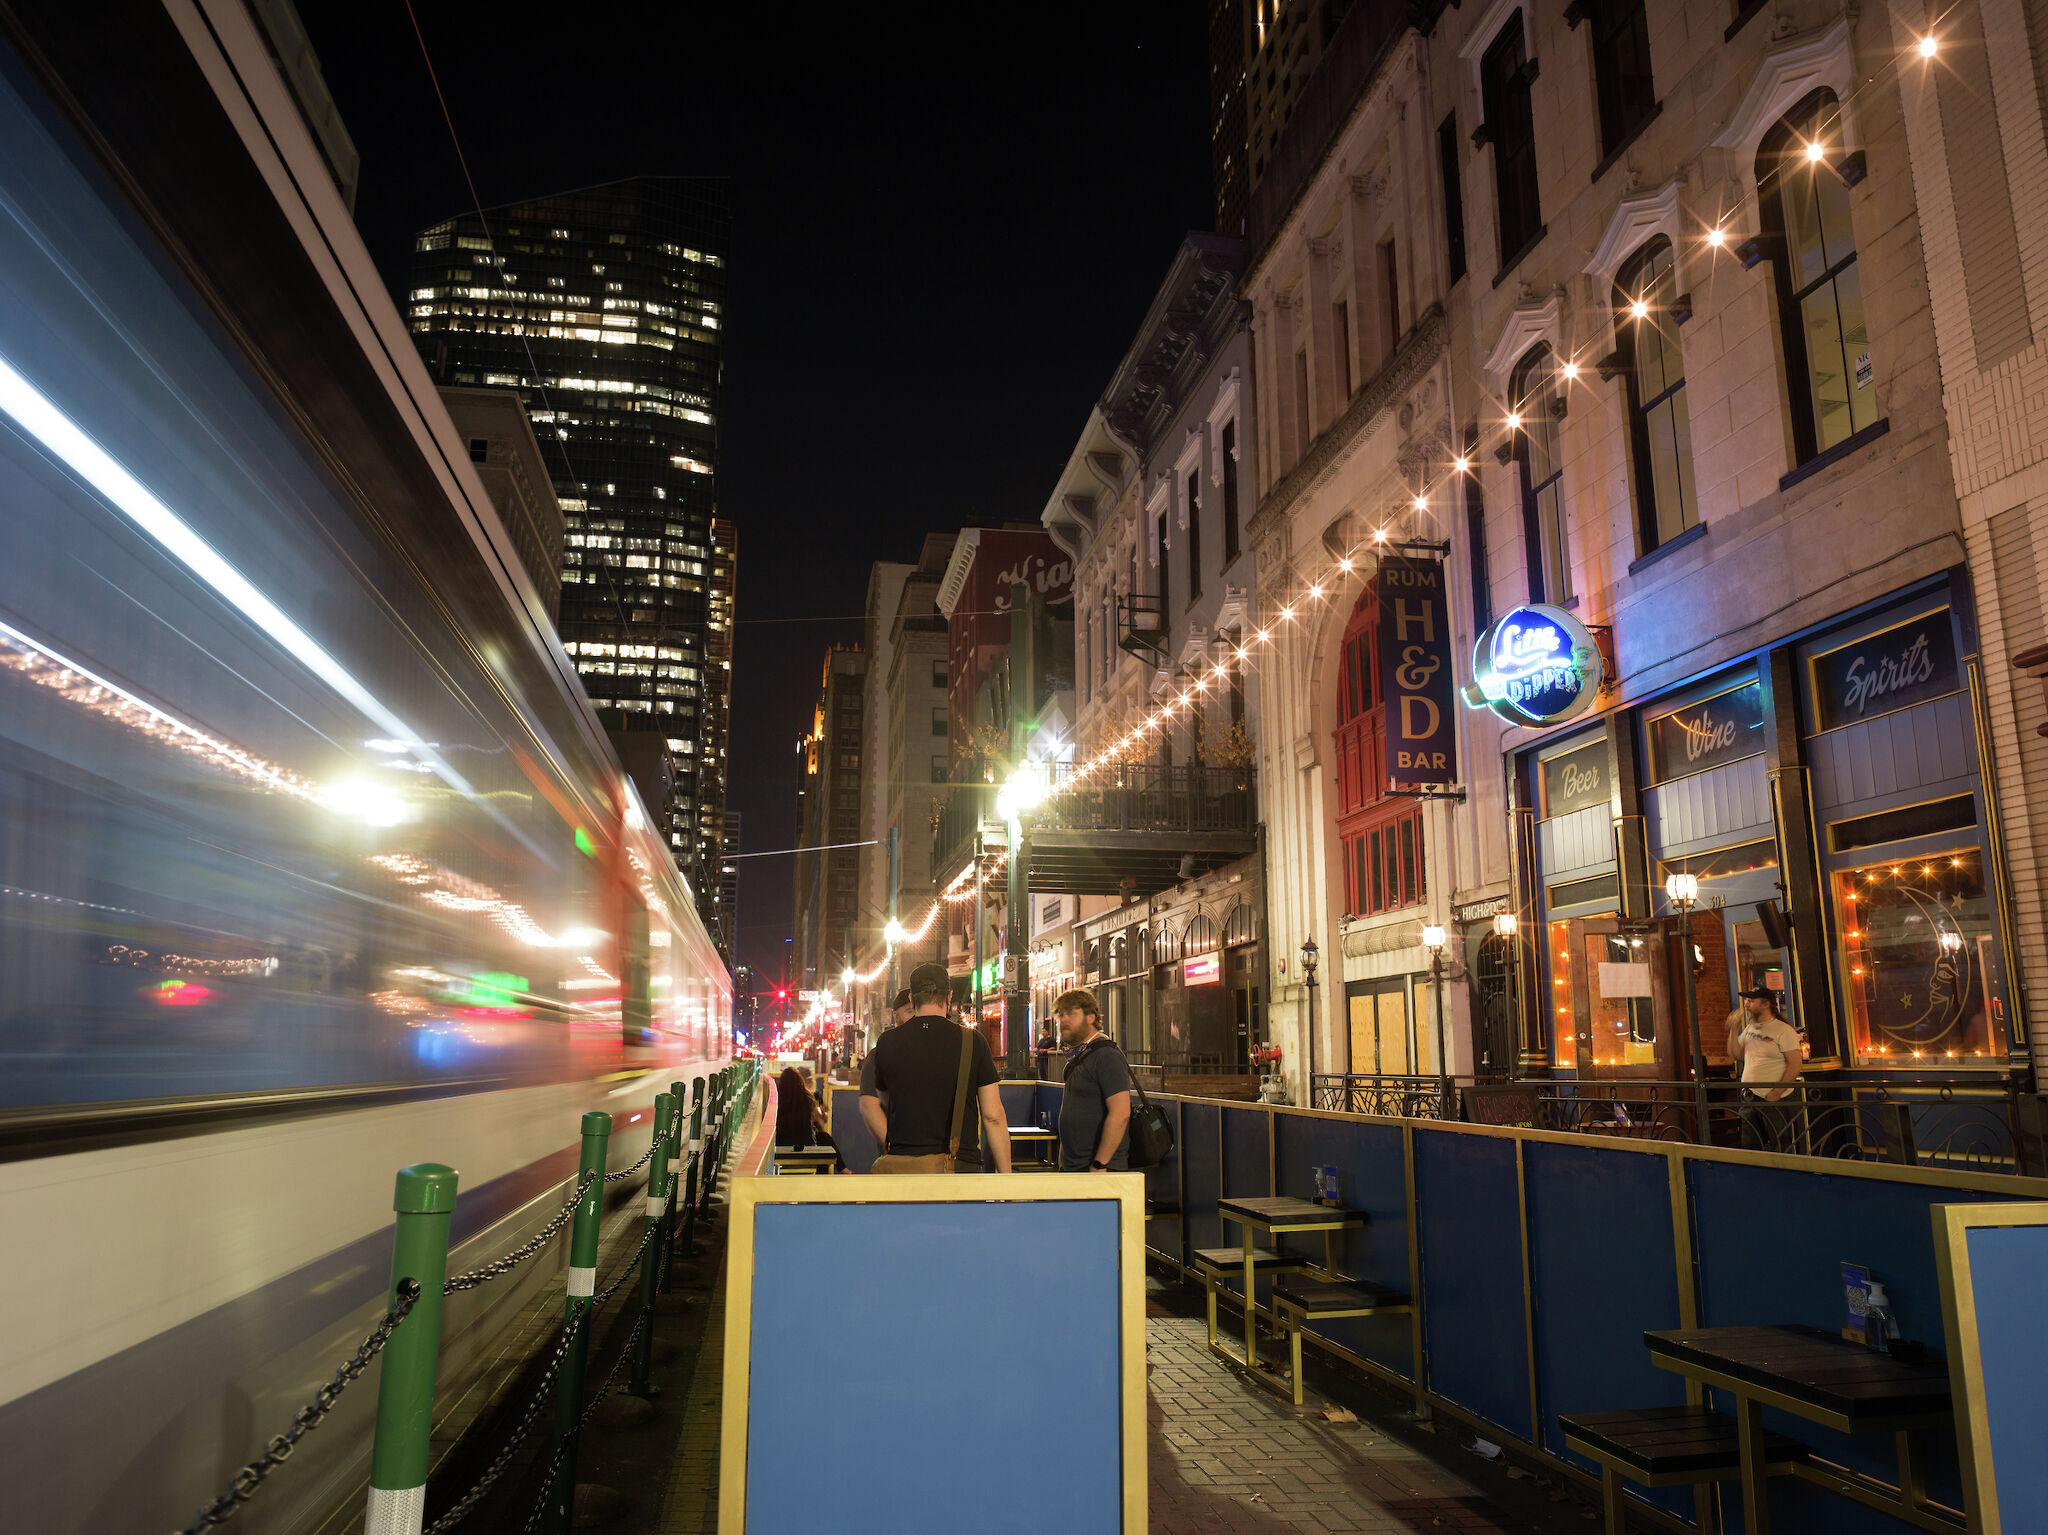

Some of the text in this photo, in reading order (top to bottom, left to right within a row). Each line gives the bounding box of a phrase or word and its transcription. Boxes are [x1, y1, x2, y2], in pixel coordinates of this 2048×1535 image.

[1386, 569, 1437, 588] RUM
[1844, 632, 1934, 714] Spirits
[1686, 710, 1736, 762] Wine
[1397, 751, 1446, 769] BAR
[1562, 763, 1599, 799] Beer
[1709, 893, 1726, 909] 304
